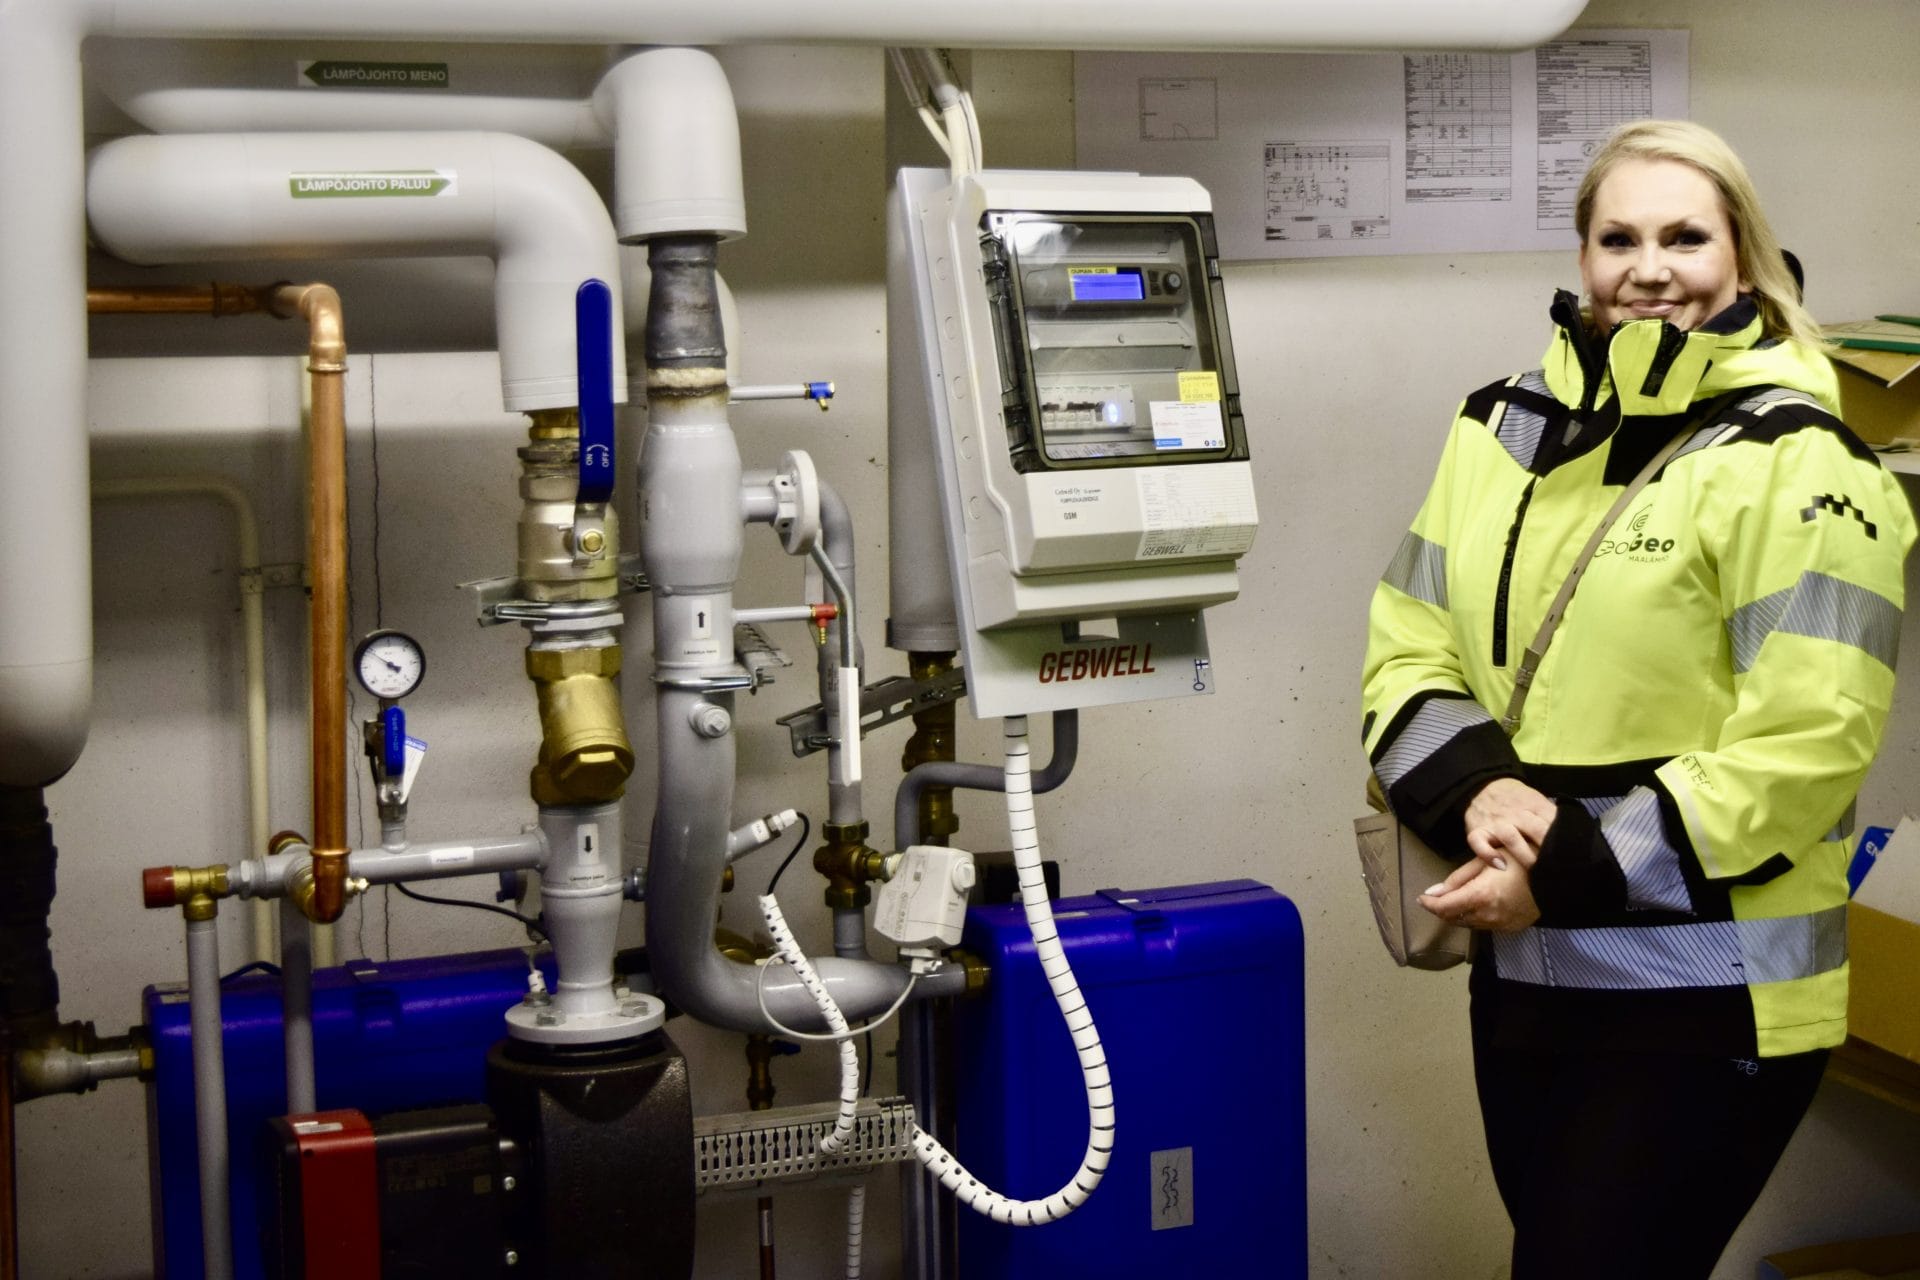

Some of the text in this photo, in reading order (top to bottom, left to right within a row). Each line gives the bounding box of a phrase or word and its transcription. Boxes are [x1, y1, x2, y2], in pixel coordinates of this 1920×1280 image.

[323, 67, 446, 81] LÄMPÖJOHTO MENO
[298, 178, 431, 192] LÄMPÖJOHTO PALUU
[586, 453, 593, 465] ON
[1064, 512, 1077, 520] GSM
[1142, 544, 1187, 556] GEBWELL
[1039, 644, 1155, 684] GEBWELL
